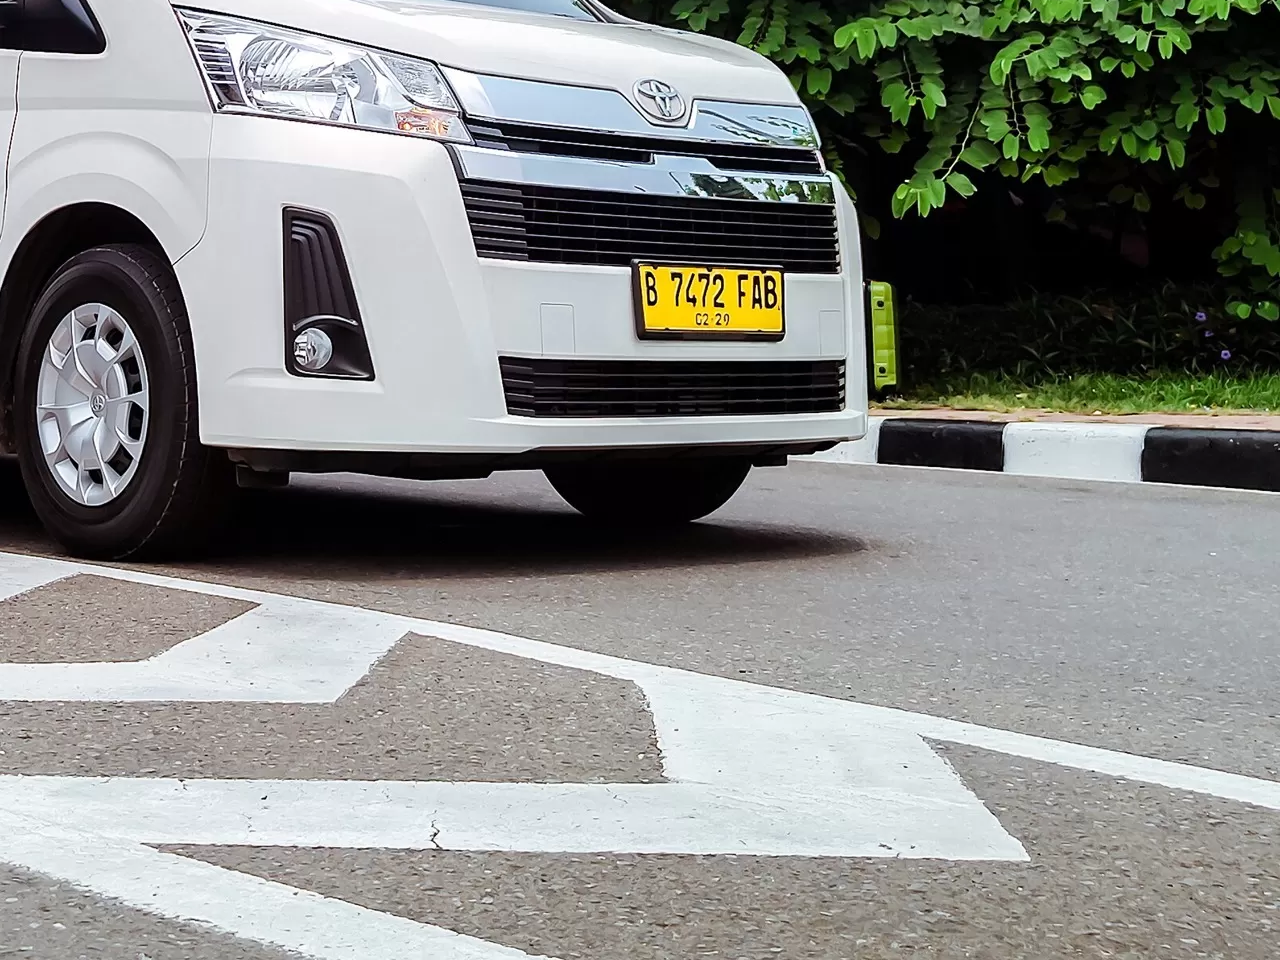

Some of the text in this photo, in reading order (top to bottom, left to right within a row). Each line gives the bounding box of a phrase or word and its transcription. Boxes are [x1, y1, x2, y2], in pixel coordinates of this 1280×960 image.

[645, 271, 778, 310] B 7472 FAB
